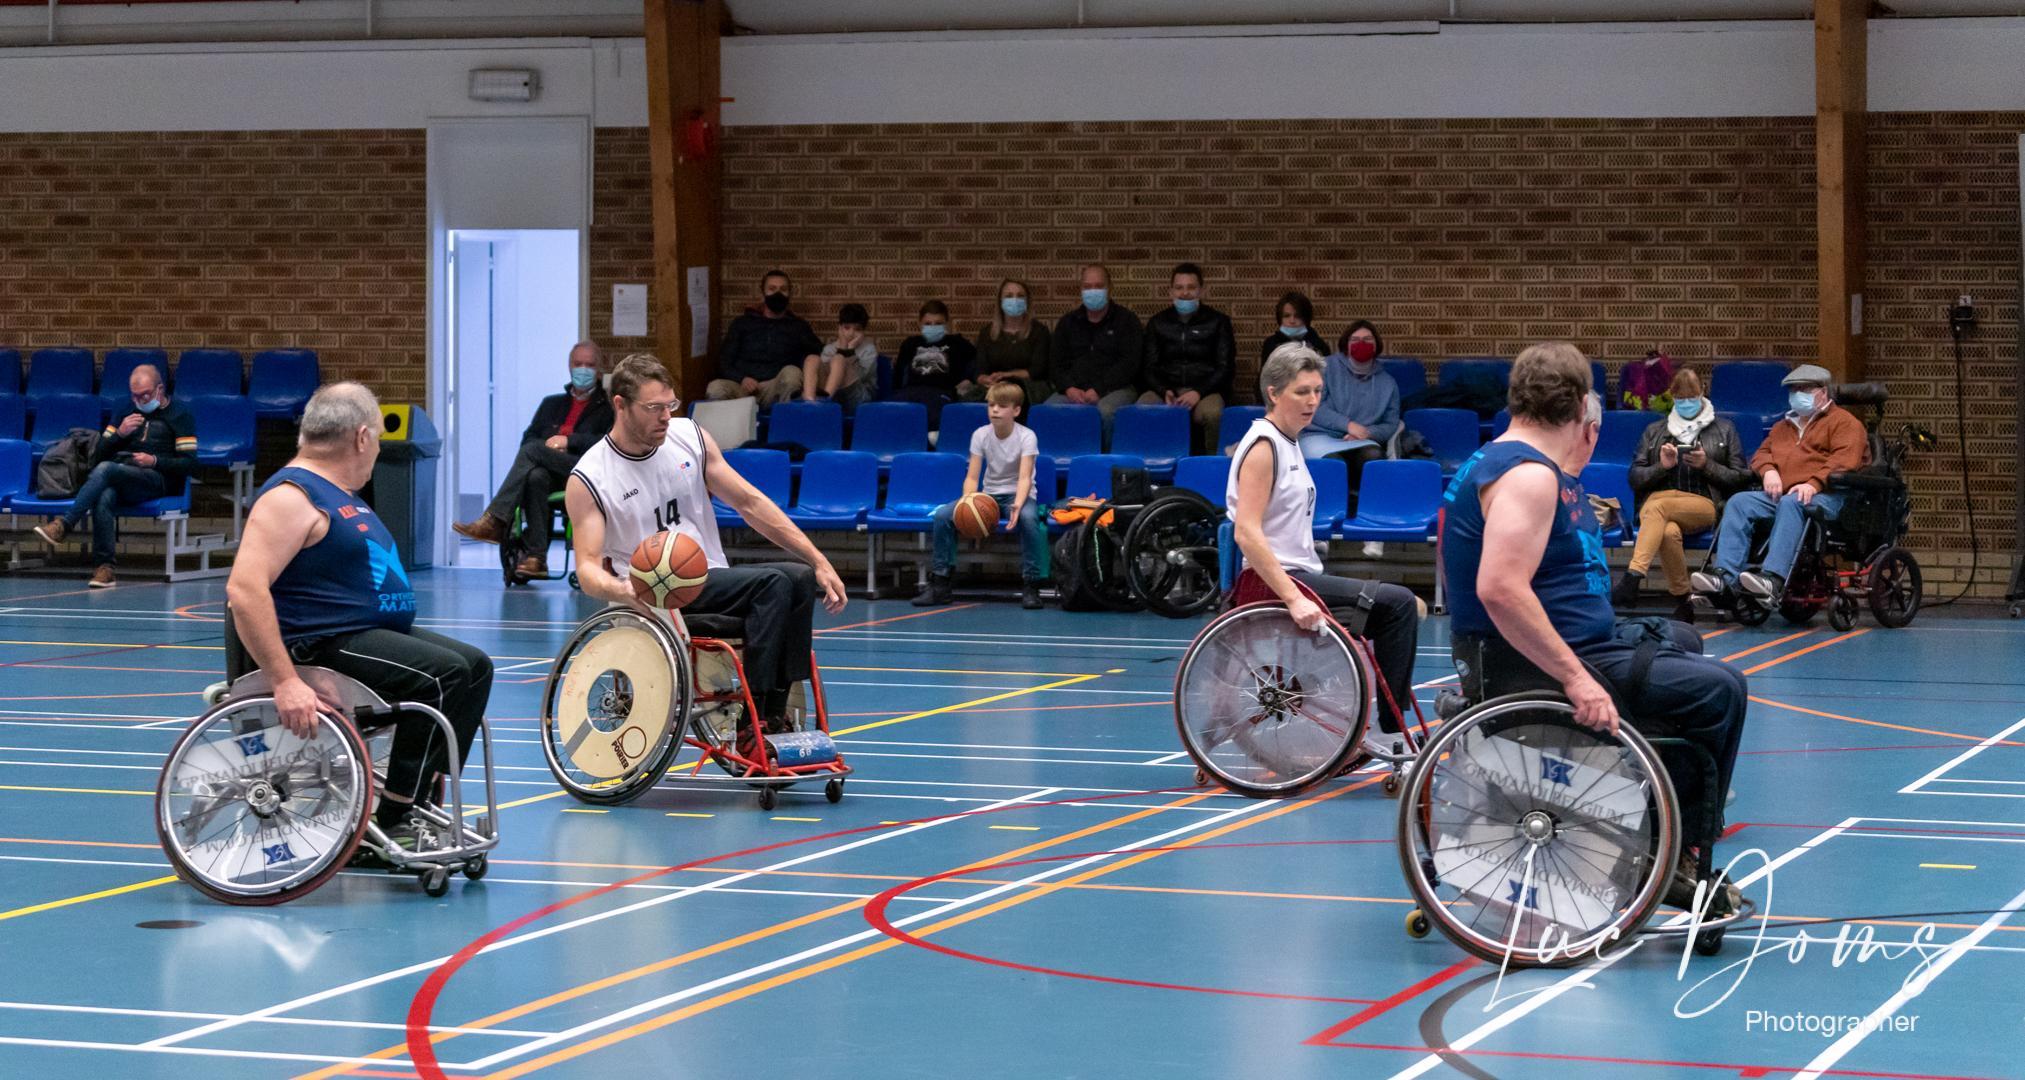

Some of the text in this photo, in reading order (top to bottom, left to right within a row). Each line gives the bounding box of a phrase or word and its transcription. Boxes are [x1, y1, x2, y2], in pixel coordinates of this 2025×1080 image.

[622, 488, 639, 501] JAKO
[654, 498, 681, 532] 14
[611, 740, 630, 770] POIRIER
